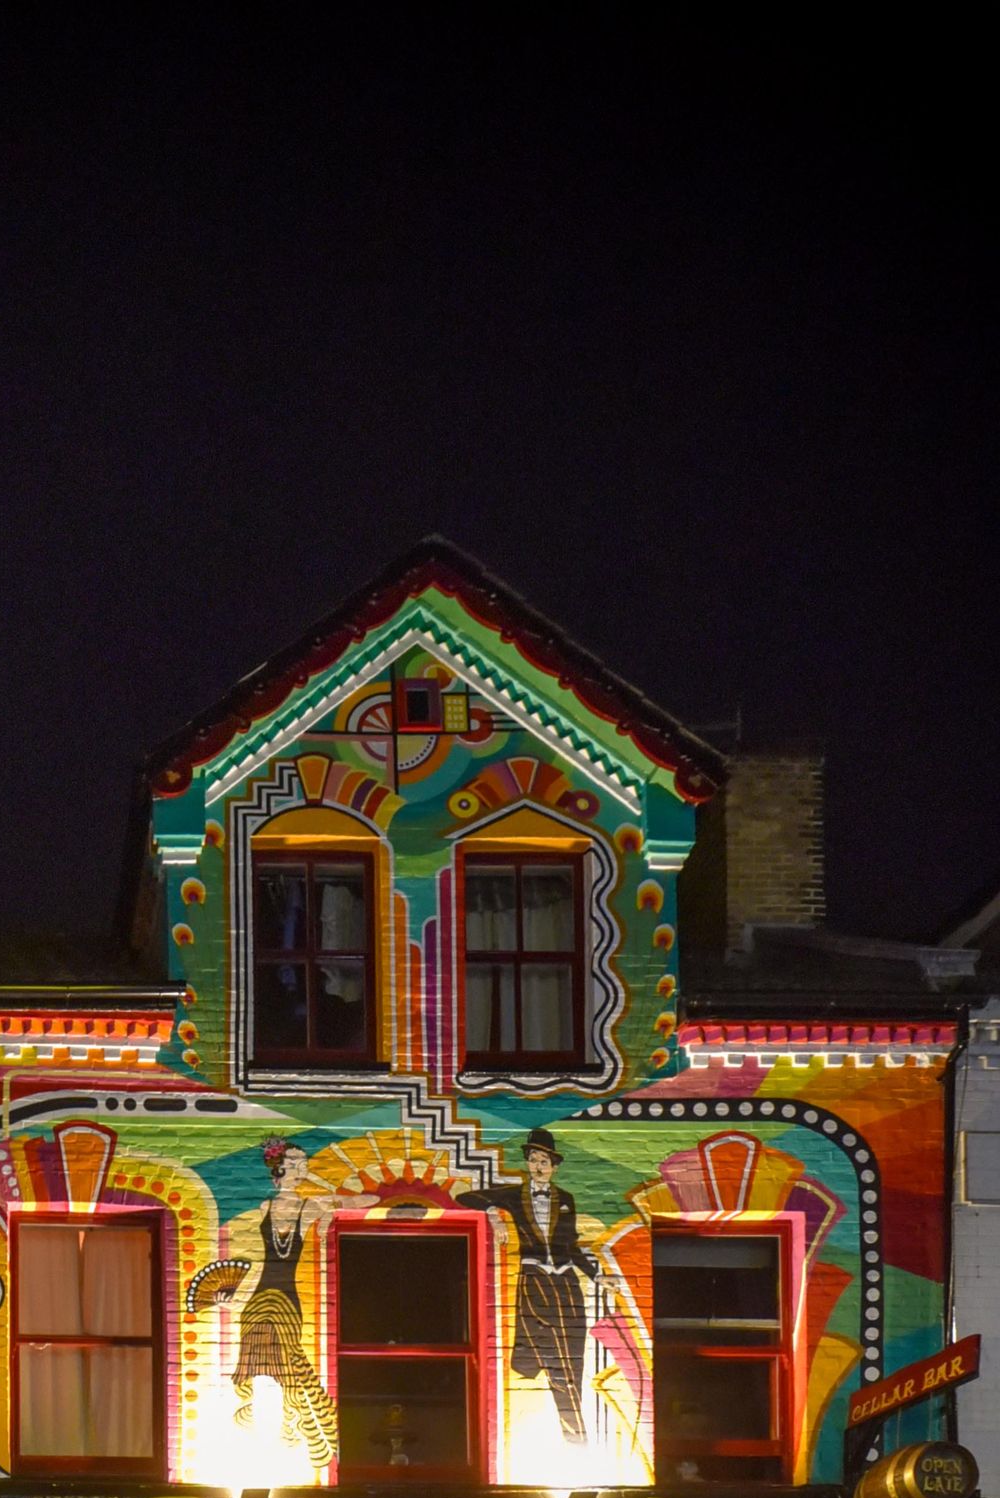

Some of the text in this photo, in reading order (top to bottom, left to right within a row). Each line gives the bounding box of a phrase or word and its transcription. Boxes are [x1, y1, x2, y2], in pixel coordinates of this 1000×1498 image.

[852, 1355, 965, 1422] CELLAR BAR
[921, 1458, 962, 1474] OPEN
[923, 1476, 962, 1493] LATE
